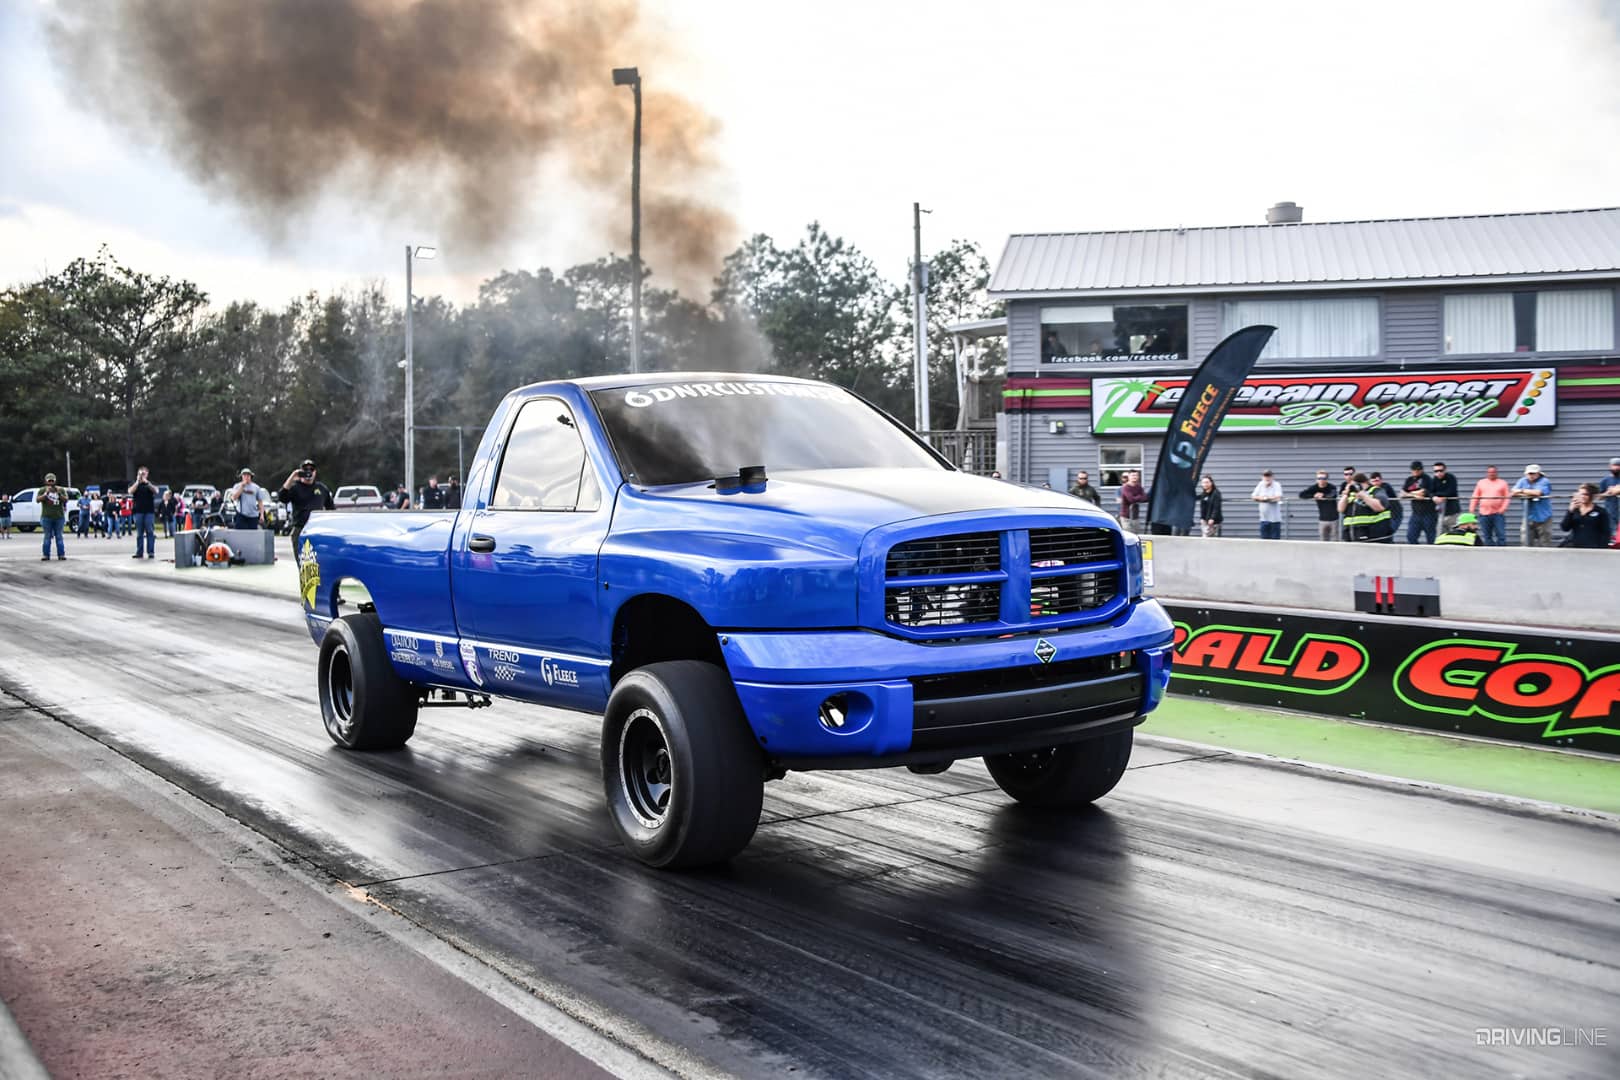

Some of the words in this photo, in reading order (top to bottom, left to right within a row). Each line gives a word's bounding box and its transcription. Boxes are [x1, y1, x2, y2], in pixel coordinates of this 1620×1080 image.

[1051, 353, 1179, 363] facebook.com/raceecd
[1365, 379, 1519, 403] COAST
[1279, 398, 1497, 429] Dragway
[488, 648, 520, 663] TREND
[553, 664, 578, 684] FLEECE
